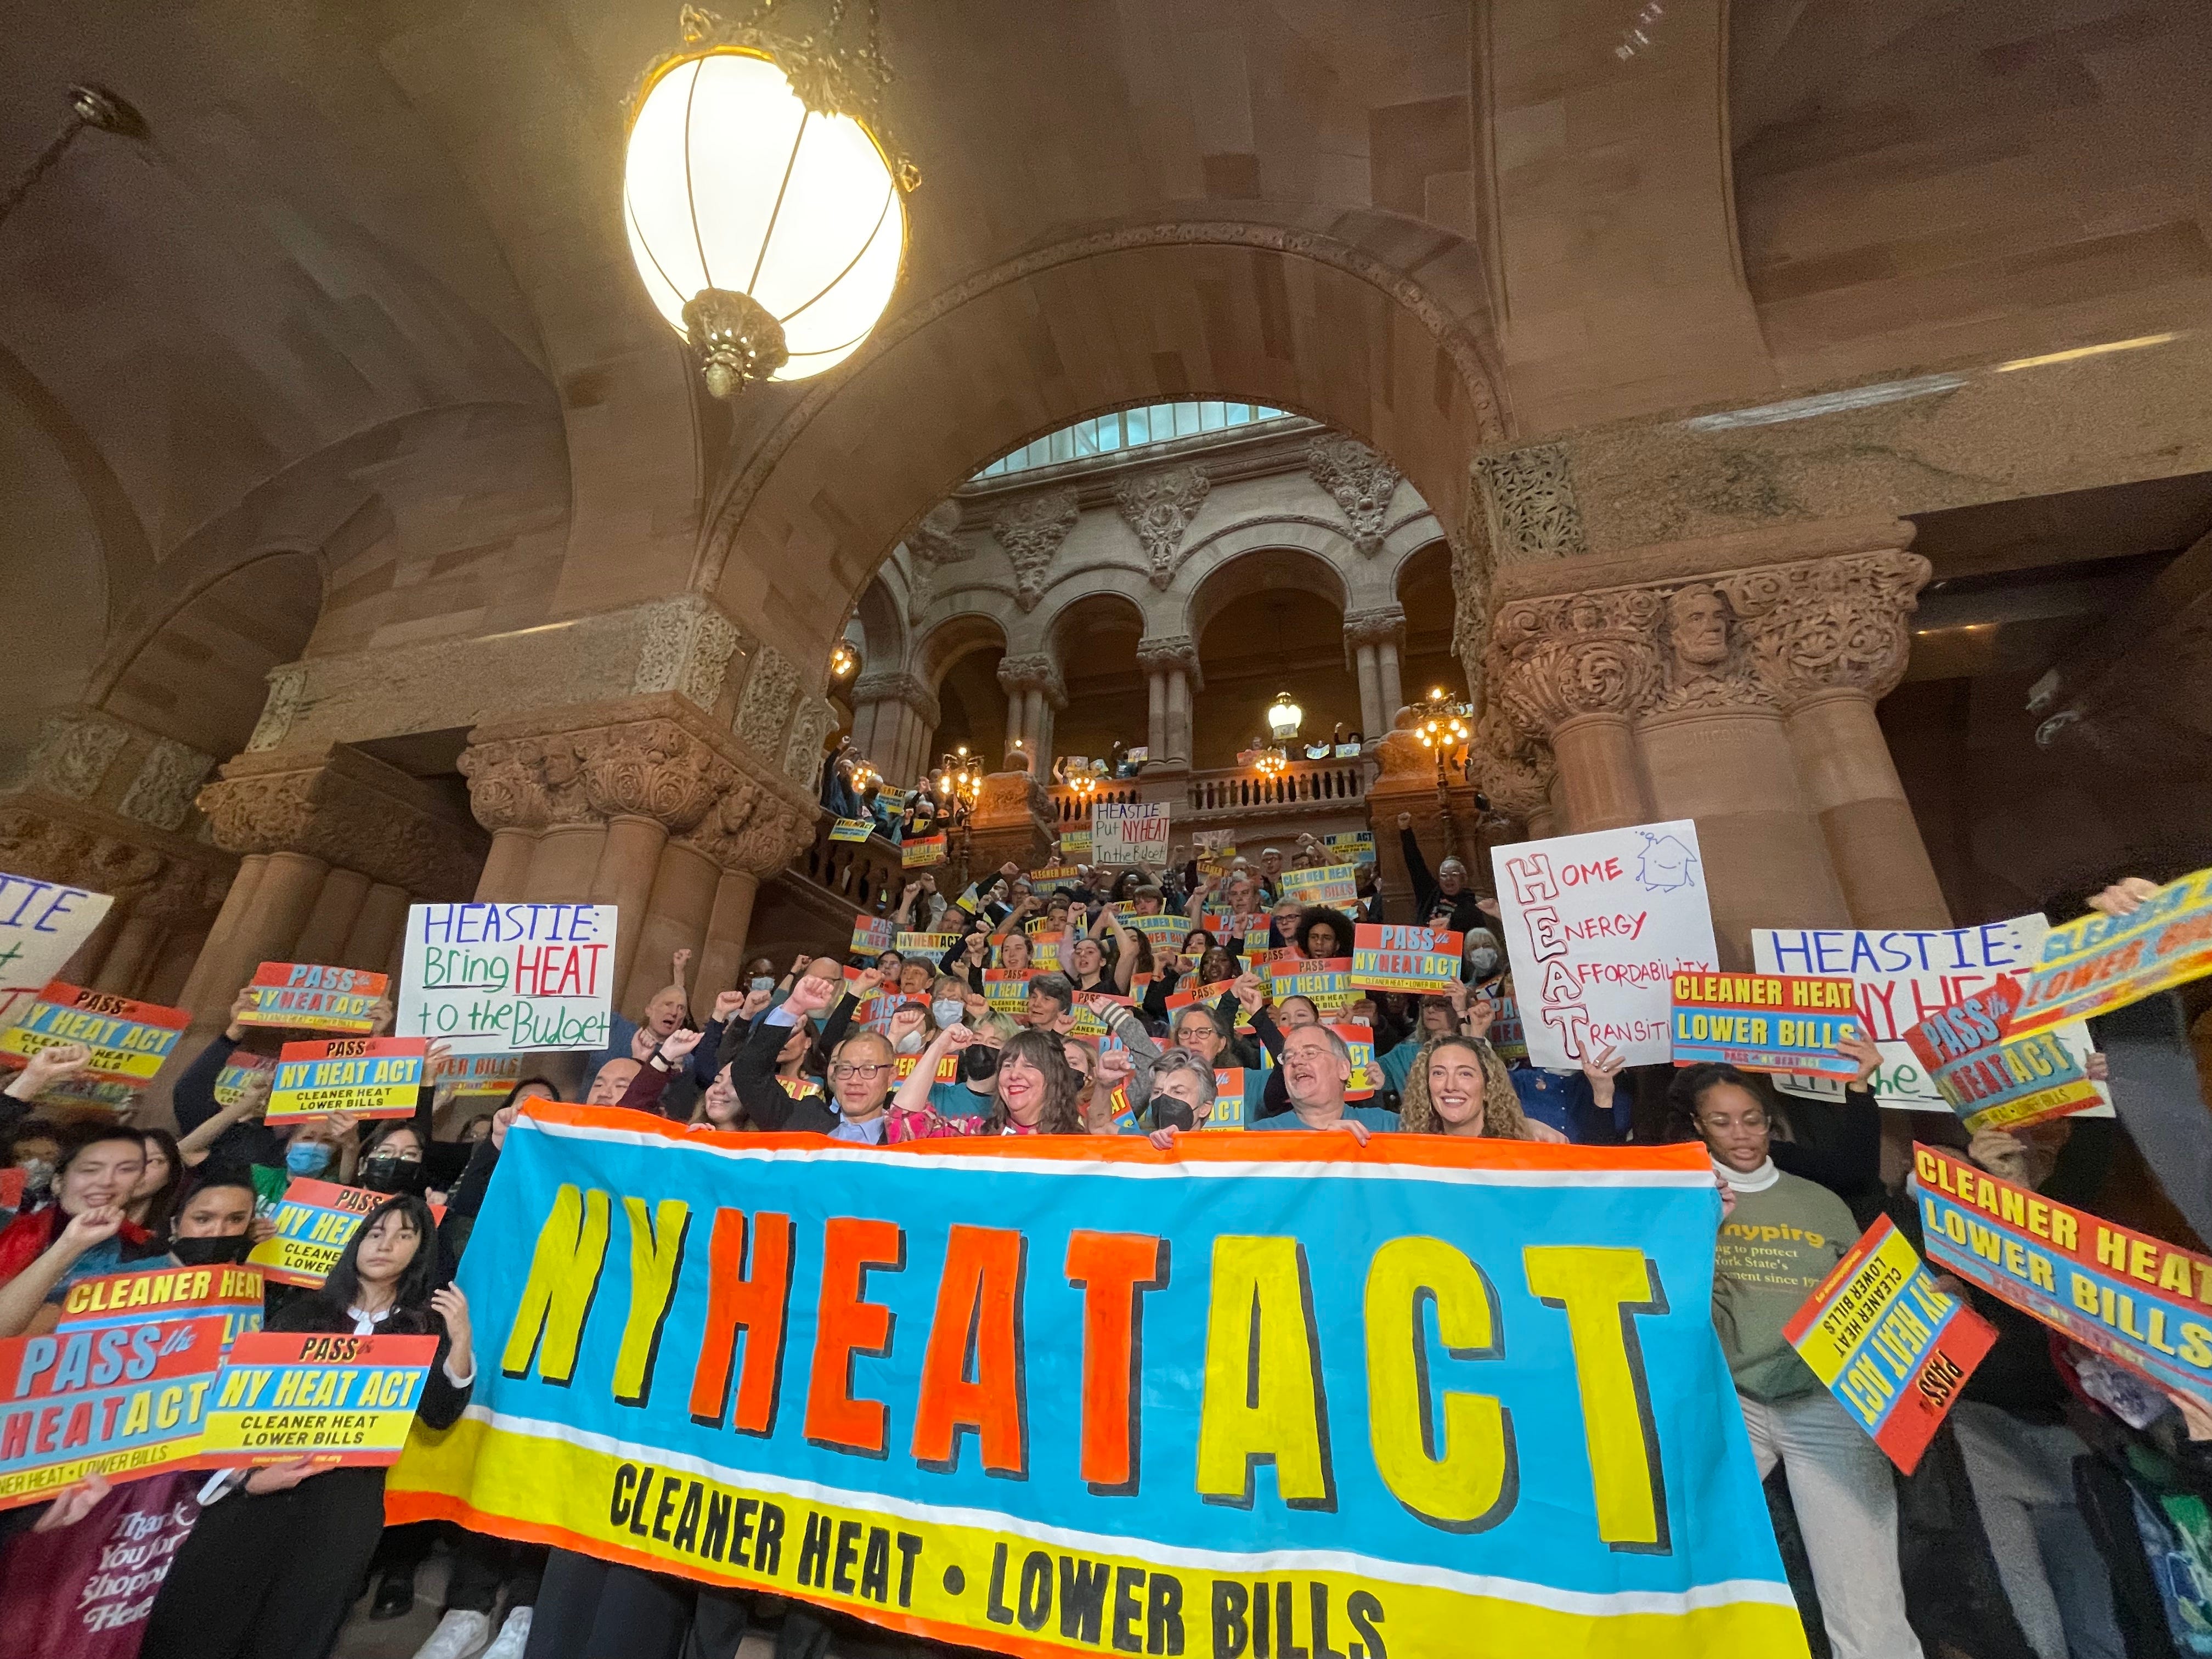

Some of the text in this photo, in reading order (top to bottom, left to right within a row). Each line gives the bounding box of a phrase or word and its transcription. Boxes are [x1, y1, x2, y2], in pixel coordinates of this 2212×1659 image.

[1096, 821, 1120, 838] Put
[1357, 832, 1372, 842] ACT
[1112, 845, 1131, 862] the
[1197, 862, 1223, 877] LEANER
[425, 903, 601, 944] HEASTIE:
[871, 917, 893, 934] PAS
[867, 933, 888, 948] HEA
[913, 934, 940, 948] HEAT
[1246, 932, 1269, 945] ACT
[1381, 926, 1435, 951] PASS
[1263, 949, 1284, 962] PASS
[1299, 961, 1324, 972] PASS
[1355, 952, 1460, 977] NY HEAT ACT
[287, 964, 357, 991] PASS
[424, 944, 609, 996] Bring HEAT
[1003, 970, 1022, 979] PASS
[998, 983, 1024, 997] HEAT
[1191, 985, 1215, 1001] PASS
[1276, 977, 1292, 995] NY
[1296, 975, 1330, 993] HEAT
[1335, 974, 1351, 990] AC
[1674, 975, 1853, 1009] CLEANER HEAT
[73, 990, 127, 1015] PASS
[48, 1009, 176, 1053] HEAT ACT
[418, 1000, 610, 1049] to the Budget
[1491, 1023, 1523, 1042] HEA
[1677, 1013, 1857, 1049] LOWER BILLS
[1920, 998, 2001, 1065] PASS
[94, 1049, 136, 1062] HEAT
[327, 1041, 366, 1058] PASS
[1350, 1046, 1370, 1065] CT
[2004, 1034, 2072, 1084] ACT
[88, 1059, 121, 1070] ILLS
[279, 1059, 417, 1088] NY HEAT ACT
[475, 1057, 518, 1075] BILLS
[1874, 1064, 1920, 1096] he
[296, 1087, 393, 1101] CLEANER HEAT
[300, 1098, 383, 1111] LOWER BILLS
[276, 1205, 363, 1246] NY HEA
[1723, 1223, 1826, 1249] nypirg
[1917, 1149, 2212, 1307] CLEANER HEAT
[284, 1243, 341, 1262] CLEANE
[1735, 1245, 1747, 1254] to
[1751, 1247, 1799, 1258] protect
[1745, 1256, 1789, 1271] State's
[1764, 1273, 1799, 1285] since
[1848, 1256, 1887, 1301] LOWER
[1925, 1197, 2056, 1294] LOWER
[2071, 1271, 2212, 1369] BILLS
[65, 1270, 262, 1314] CLEANER HEAT
[1861, 1267, 1902, 1324] CLEANER
[1823, 1299, 1855, 1335] BILLS
[298, 1337, 359, 1363] PASS
[1832, 1322, 1864, 1359] HEAT
[1870, 1300, 1932, 1380] HEAT
[15, 1325, 198, 1398] PASS the
[501, 1182, 1673, 1556] NY HEAT ACT
[217, 1369, 422, 1408] NY HEAT ACT
[1839, 1352, 1895, 1426] ACT
[1916, 1347, 1966, 1408] PASS
[1, 1381, 211, 1462] HEAT ACT
[240, 1415, 379, 1429] CLEANER HEAT
[242, 1431, 364, 1446] LOWER BILLS
[28, 1466, 66, 1489] HEAT
[130, 1444, 169, 1468] BILLS
[98, 1542, 144, 1571] You
[610, 1462, 1389, 1659] CLEANER HEAT LOWER BILLS
[76, 1556, 173, 1610] Shoppi
